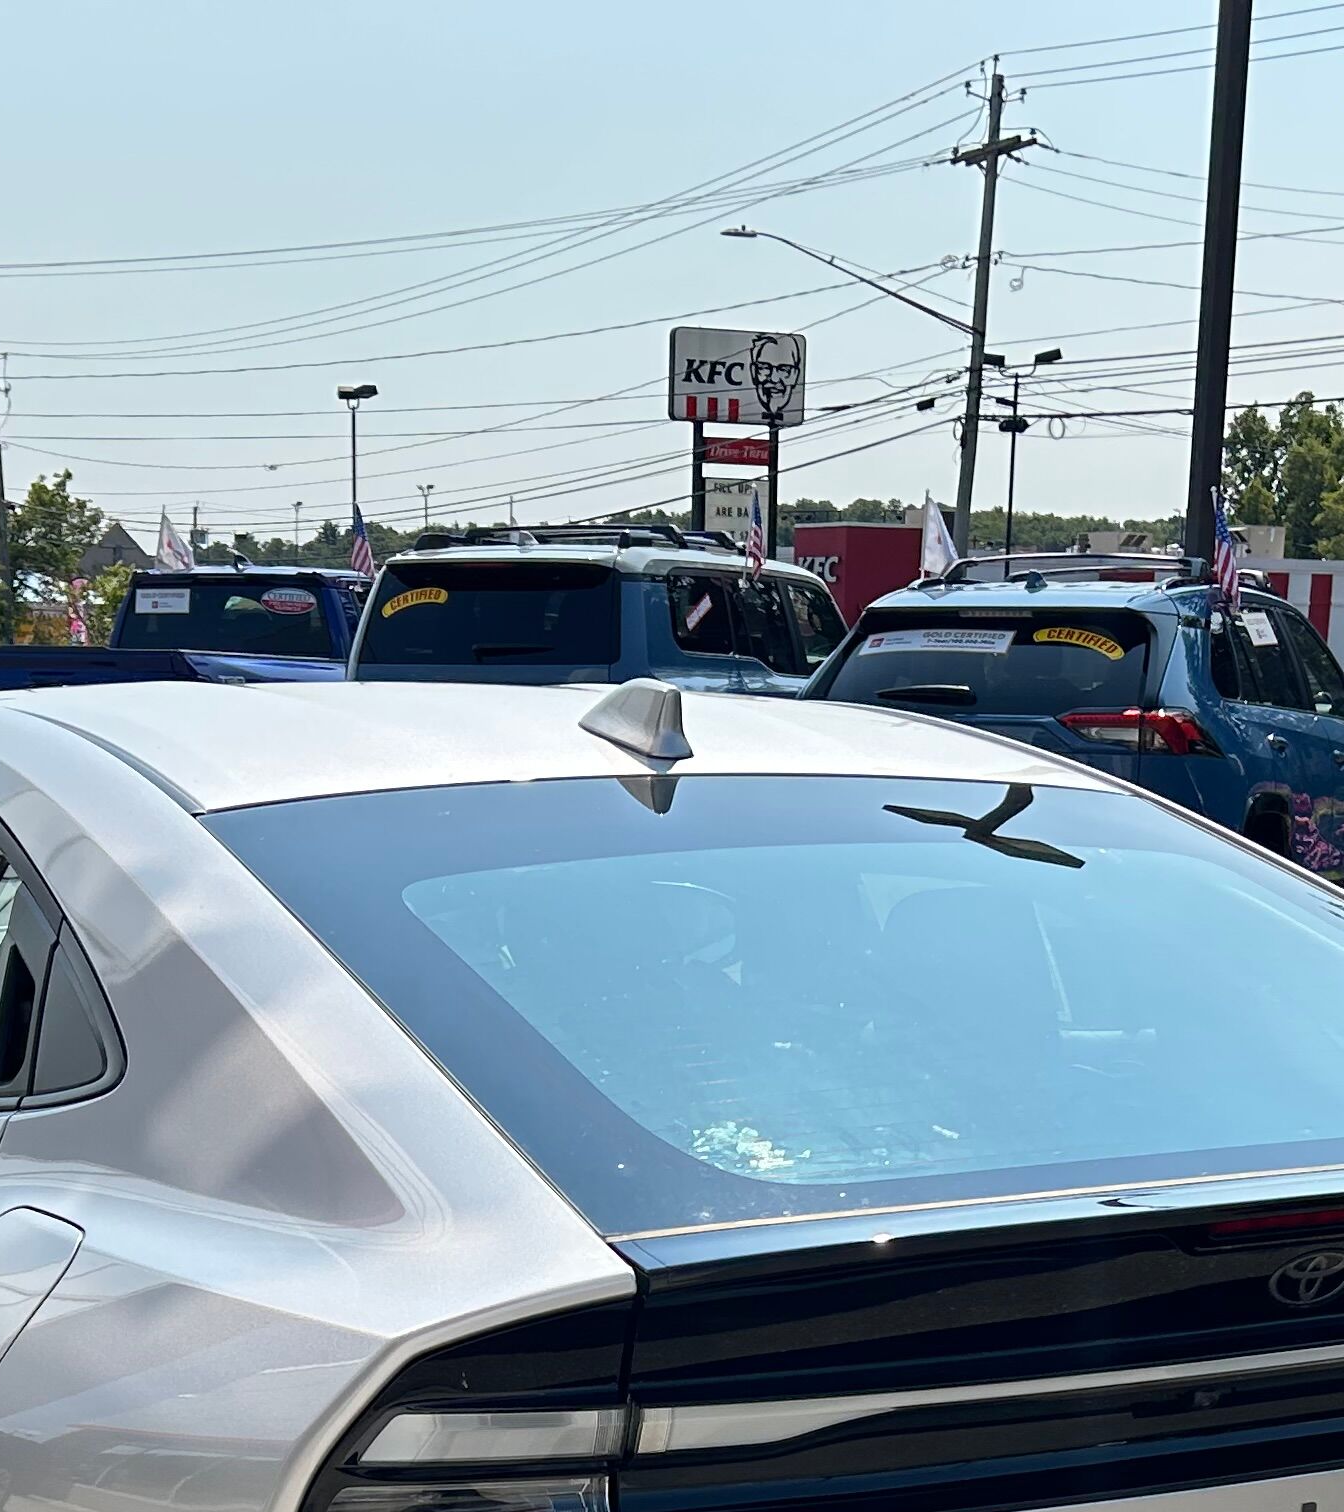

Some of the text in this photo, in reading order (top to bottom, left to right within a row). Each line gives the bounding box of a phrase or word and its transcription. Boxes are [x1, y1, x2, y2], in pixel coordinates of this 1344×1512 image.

[682, 358, 744, 386] KFC
[716, 507, 733, 517] ARE
[390, 588, 442, 611] CERTIFIED
[922, 631, 1006, 640] GOLD CERTIFIED
[1047, 629, 1118, 654] CERTIFIED
